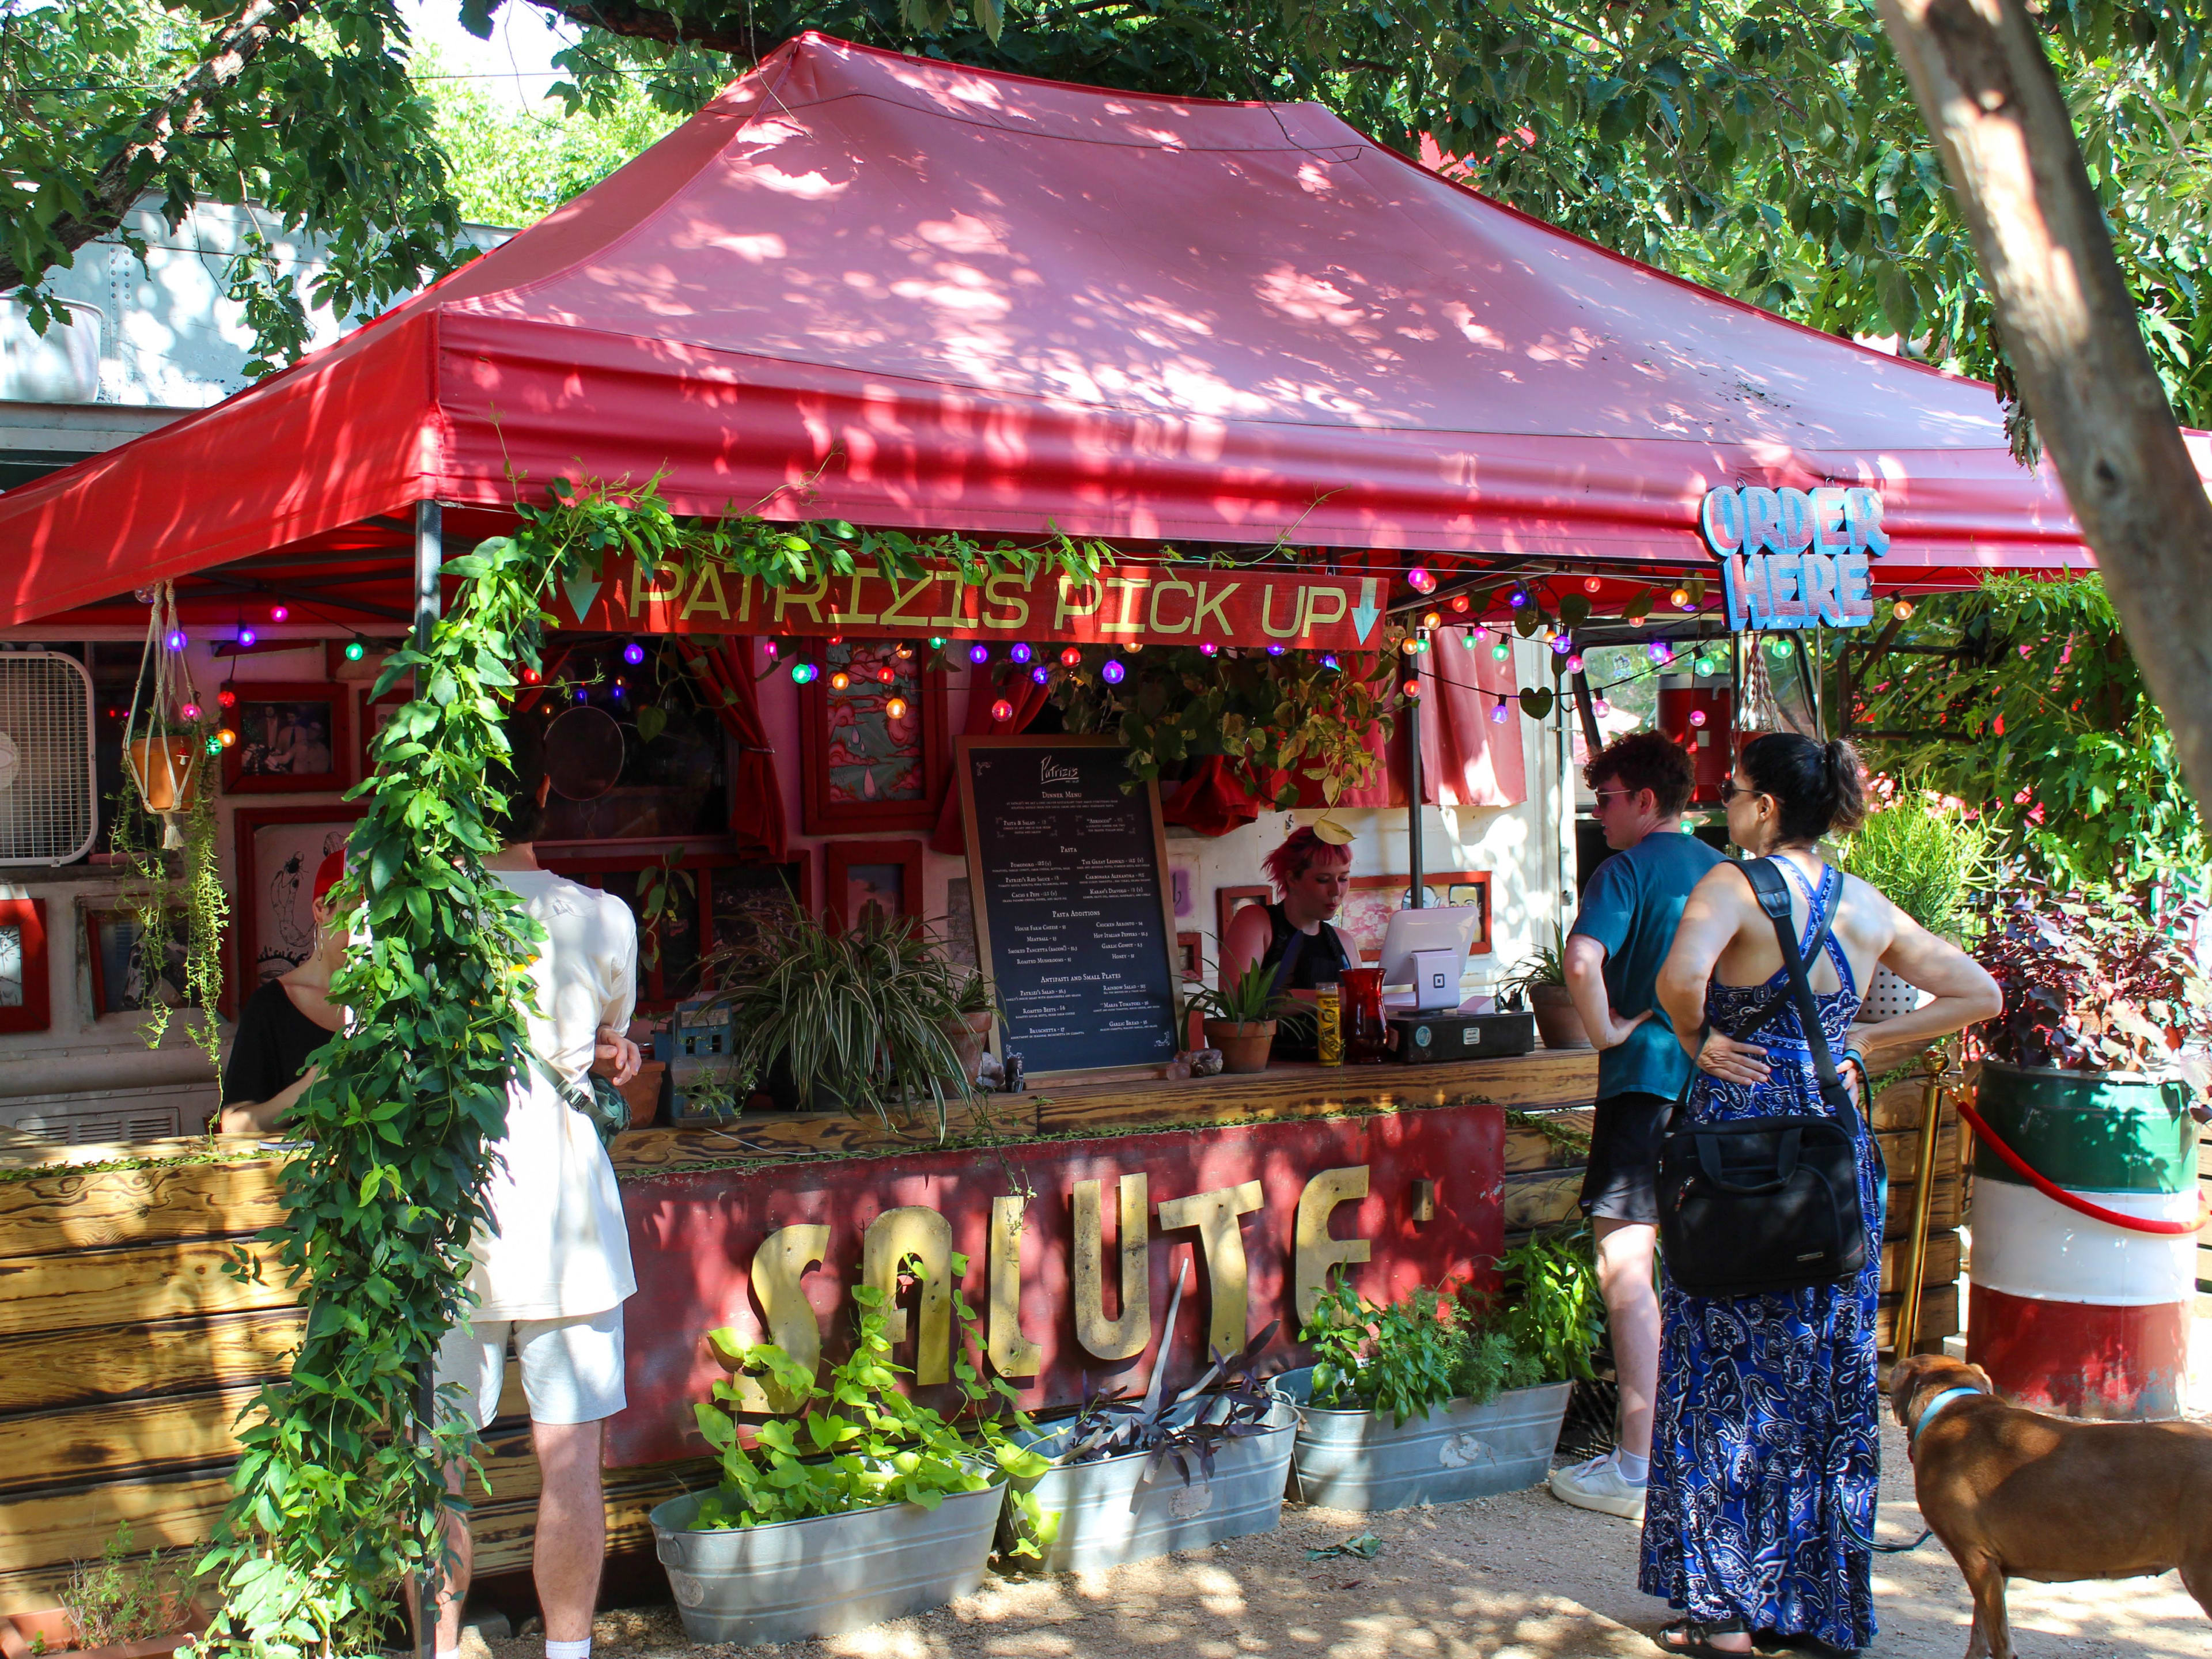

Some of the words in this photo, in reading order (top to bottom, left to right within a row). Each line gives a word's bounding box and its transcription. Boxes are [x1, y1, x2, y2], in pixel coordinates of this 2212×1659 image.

[1700, 486, 1890, 558] ORDER
[1054, 575, 1241, 635] PICK
[1262, 584, 1347, 638] UP
[1720, 554, 1874, 631] HERE
